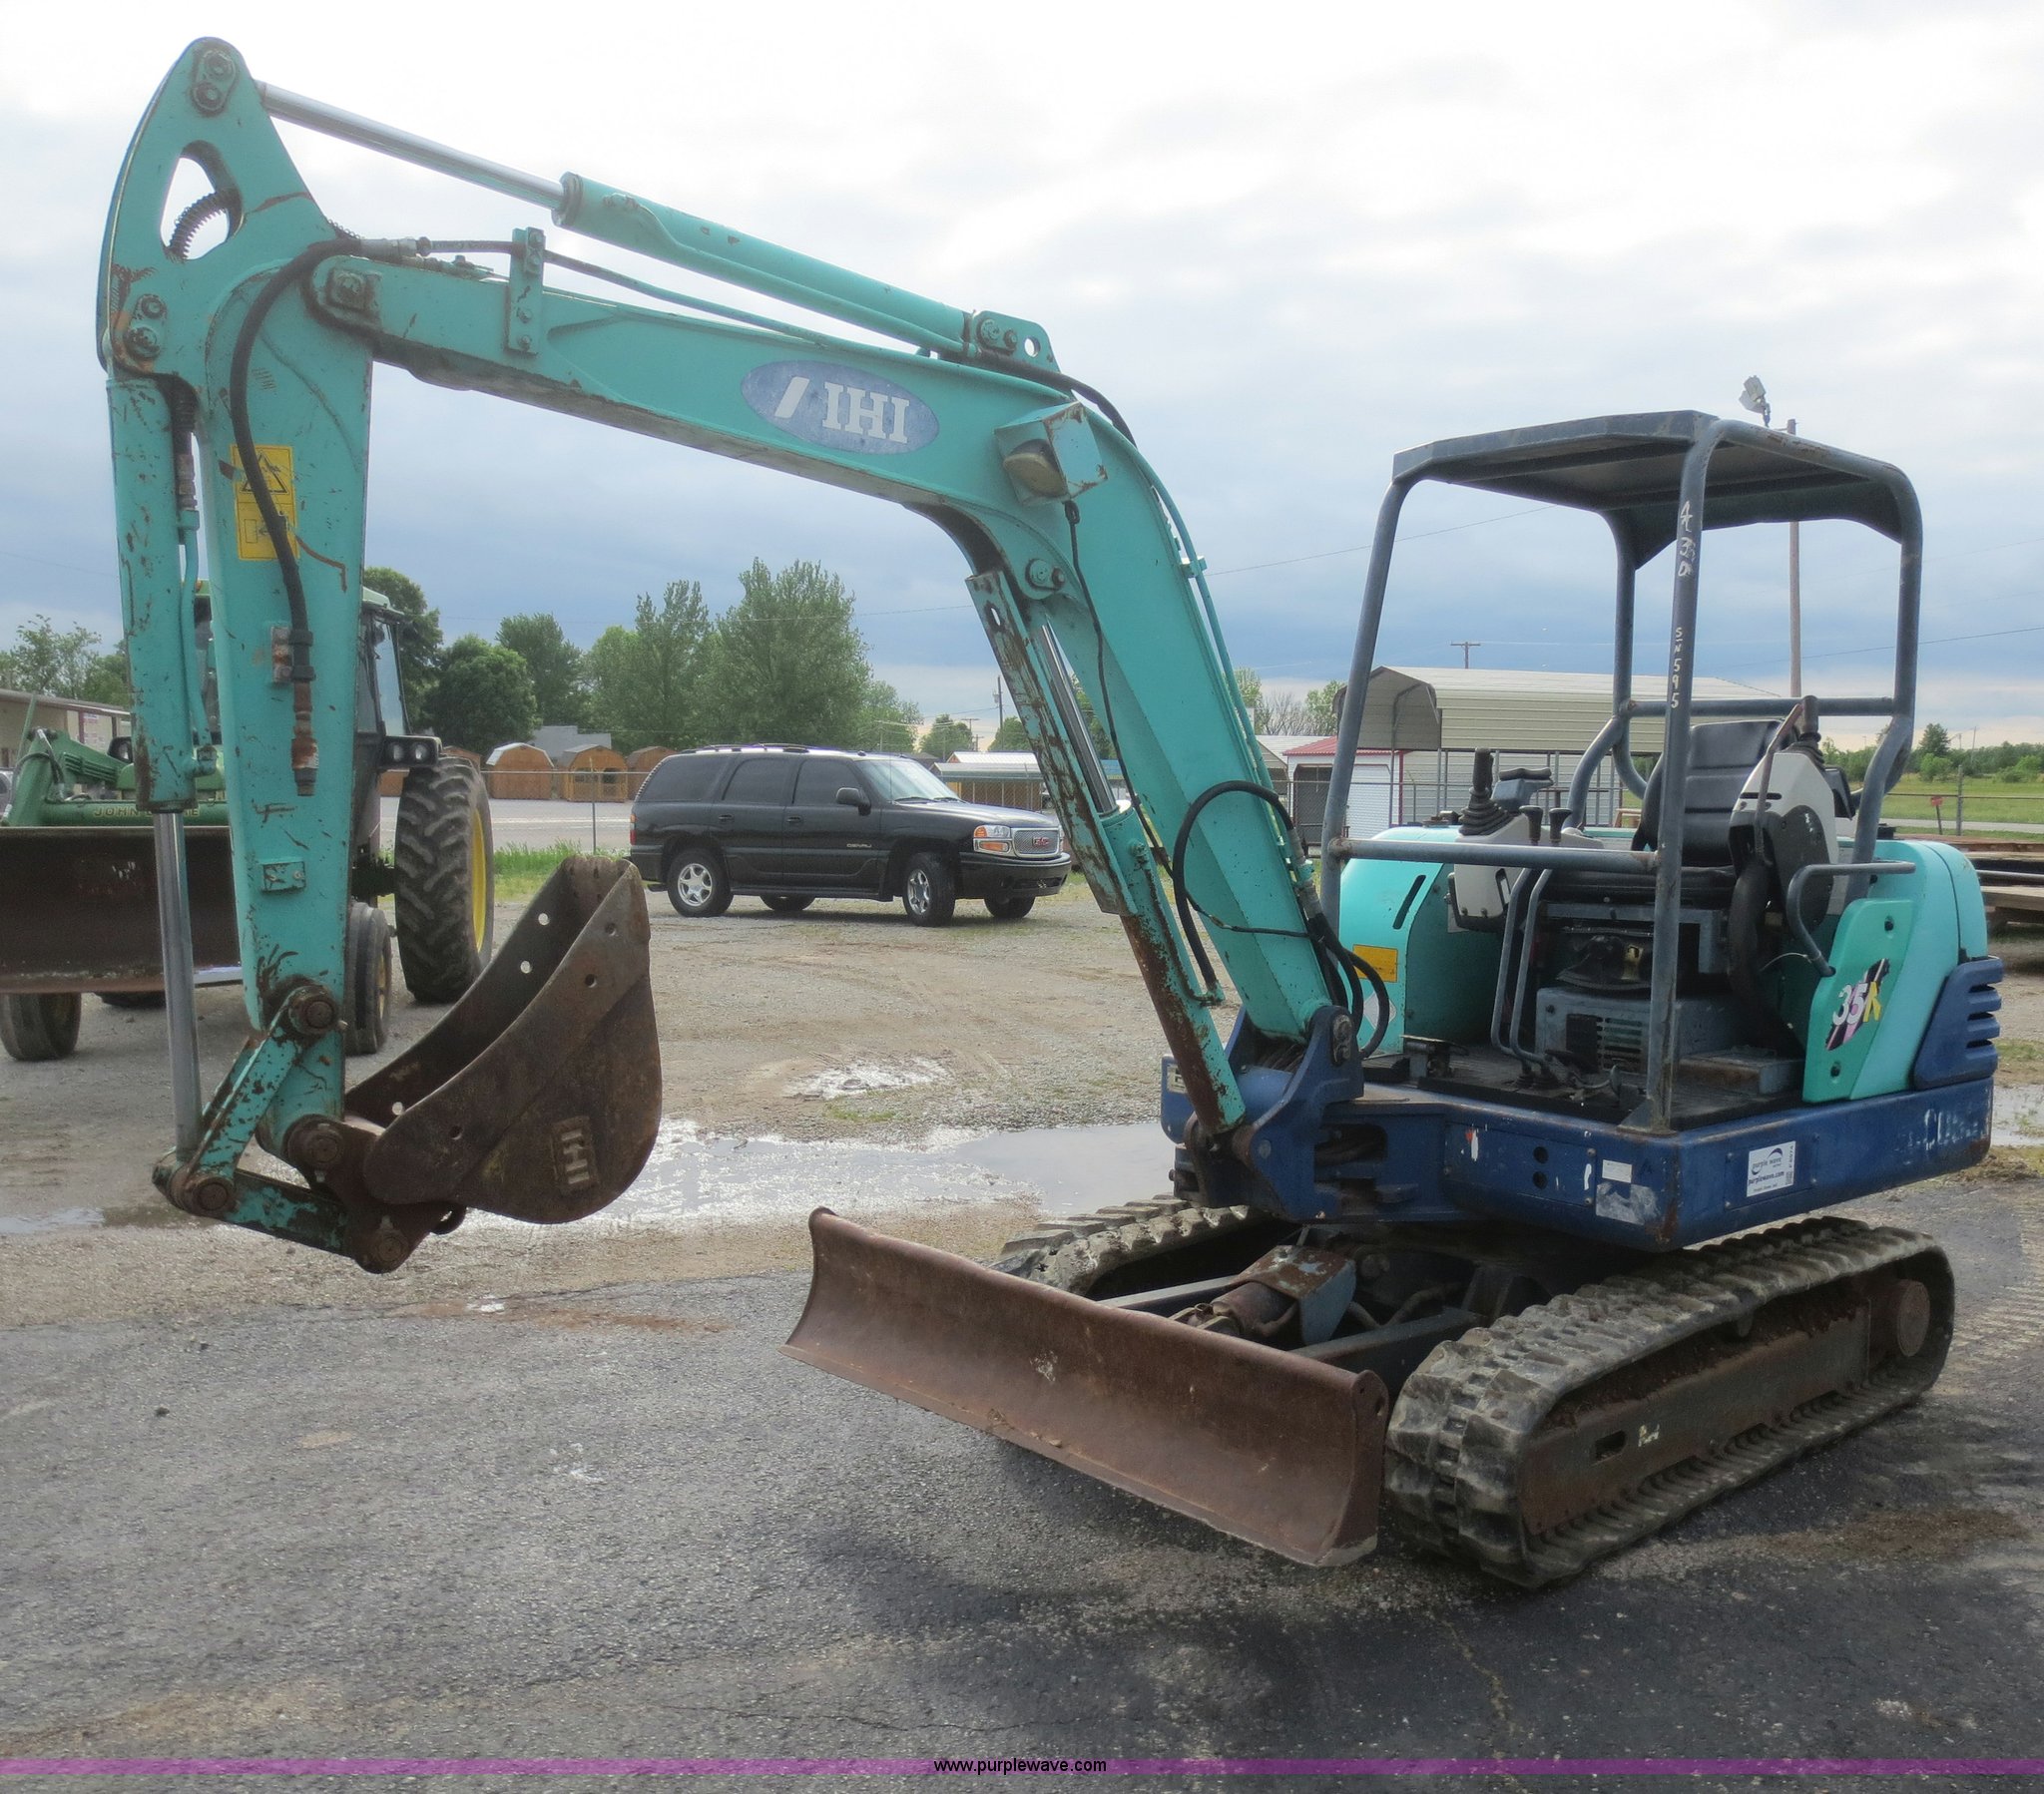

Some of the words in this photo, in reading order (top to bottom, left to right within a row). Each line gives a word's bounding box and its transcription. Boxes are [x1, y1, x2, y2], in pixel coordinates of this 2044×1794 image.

[822, 381, 910, 444] IHI
[94, 805, 139, 818] JOHN
[1832, 981, 1883, 1026] 35K
